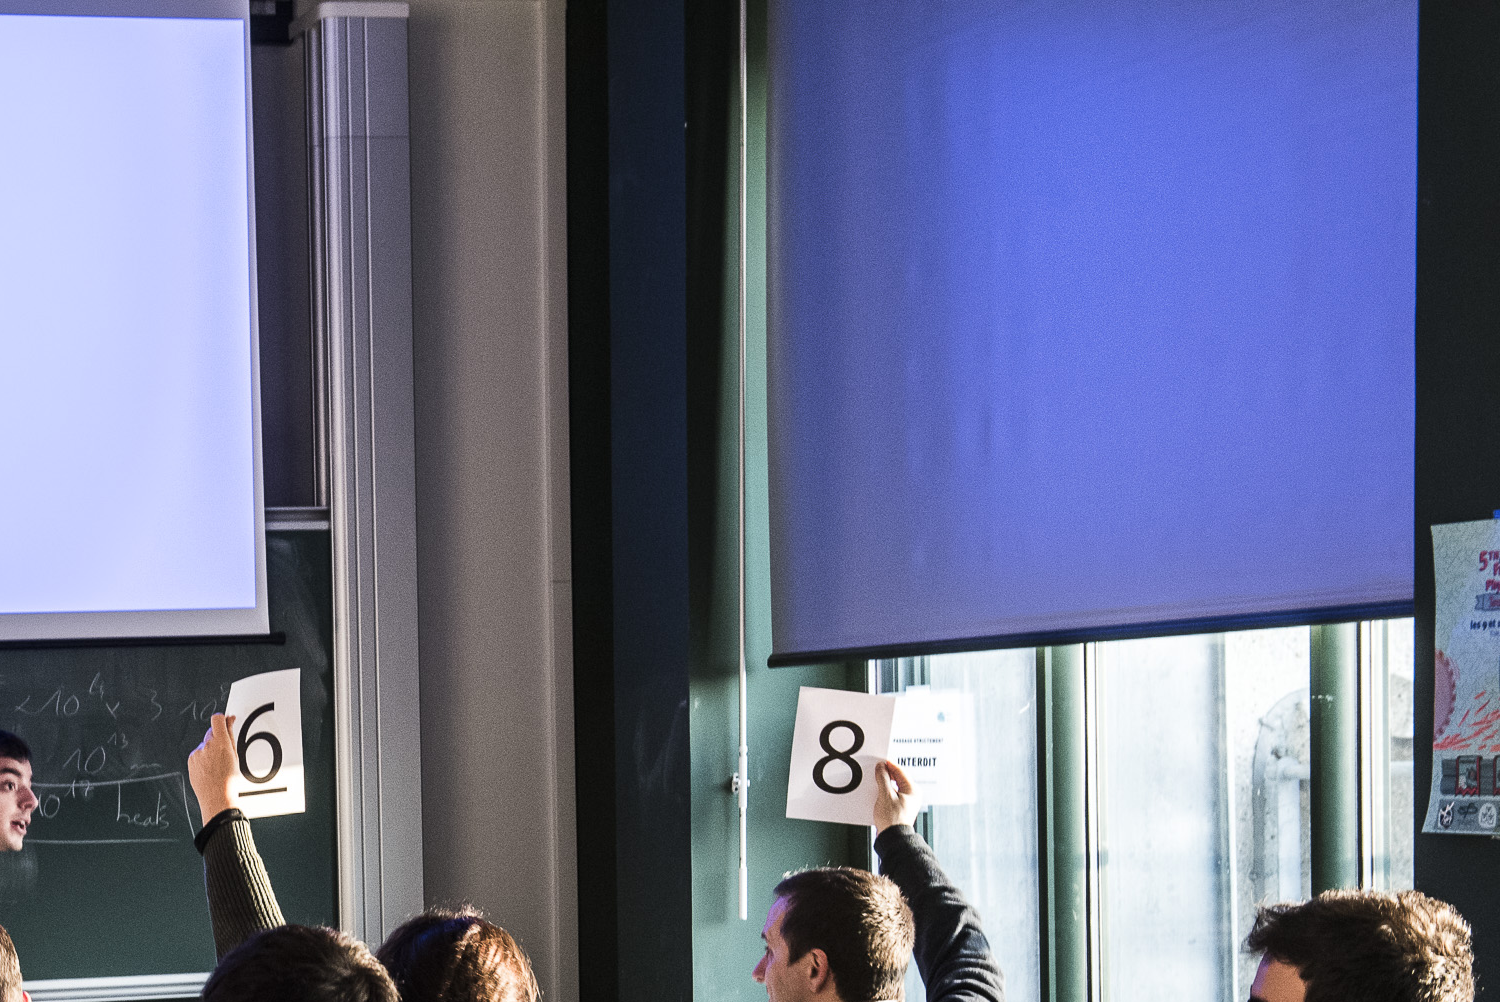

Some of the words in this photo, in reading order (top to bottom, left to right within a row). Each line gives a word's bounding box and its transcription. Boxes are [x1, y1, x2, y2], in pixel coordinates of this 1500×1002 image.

[237, 701, 283, 784] 6
[812, 720, 865, 794] 8
[897, 757, 937, 767] INTERDIT
